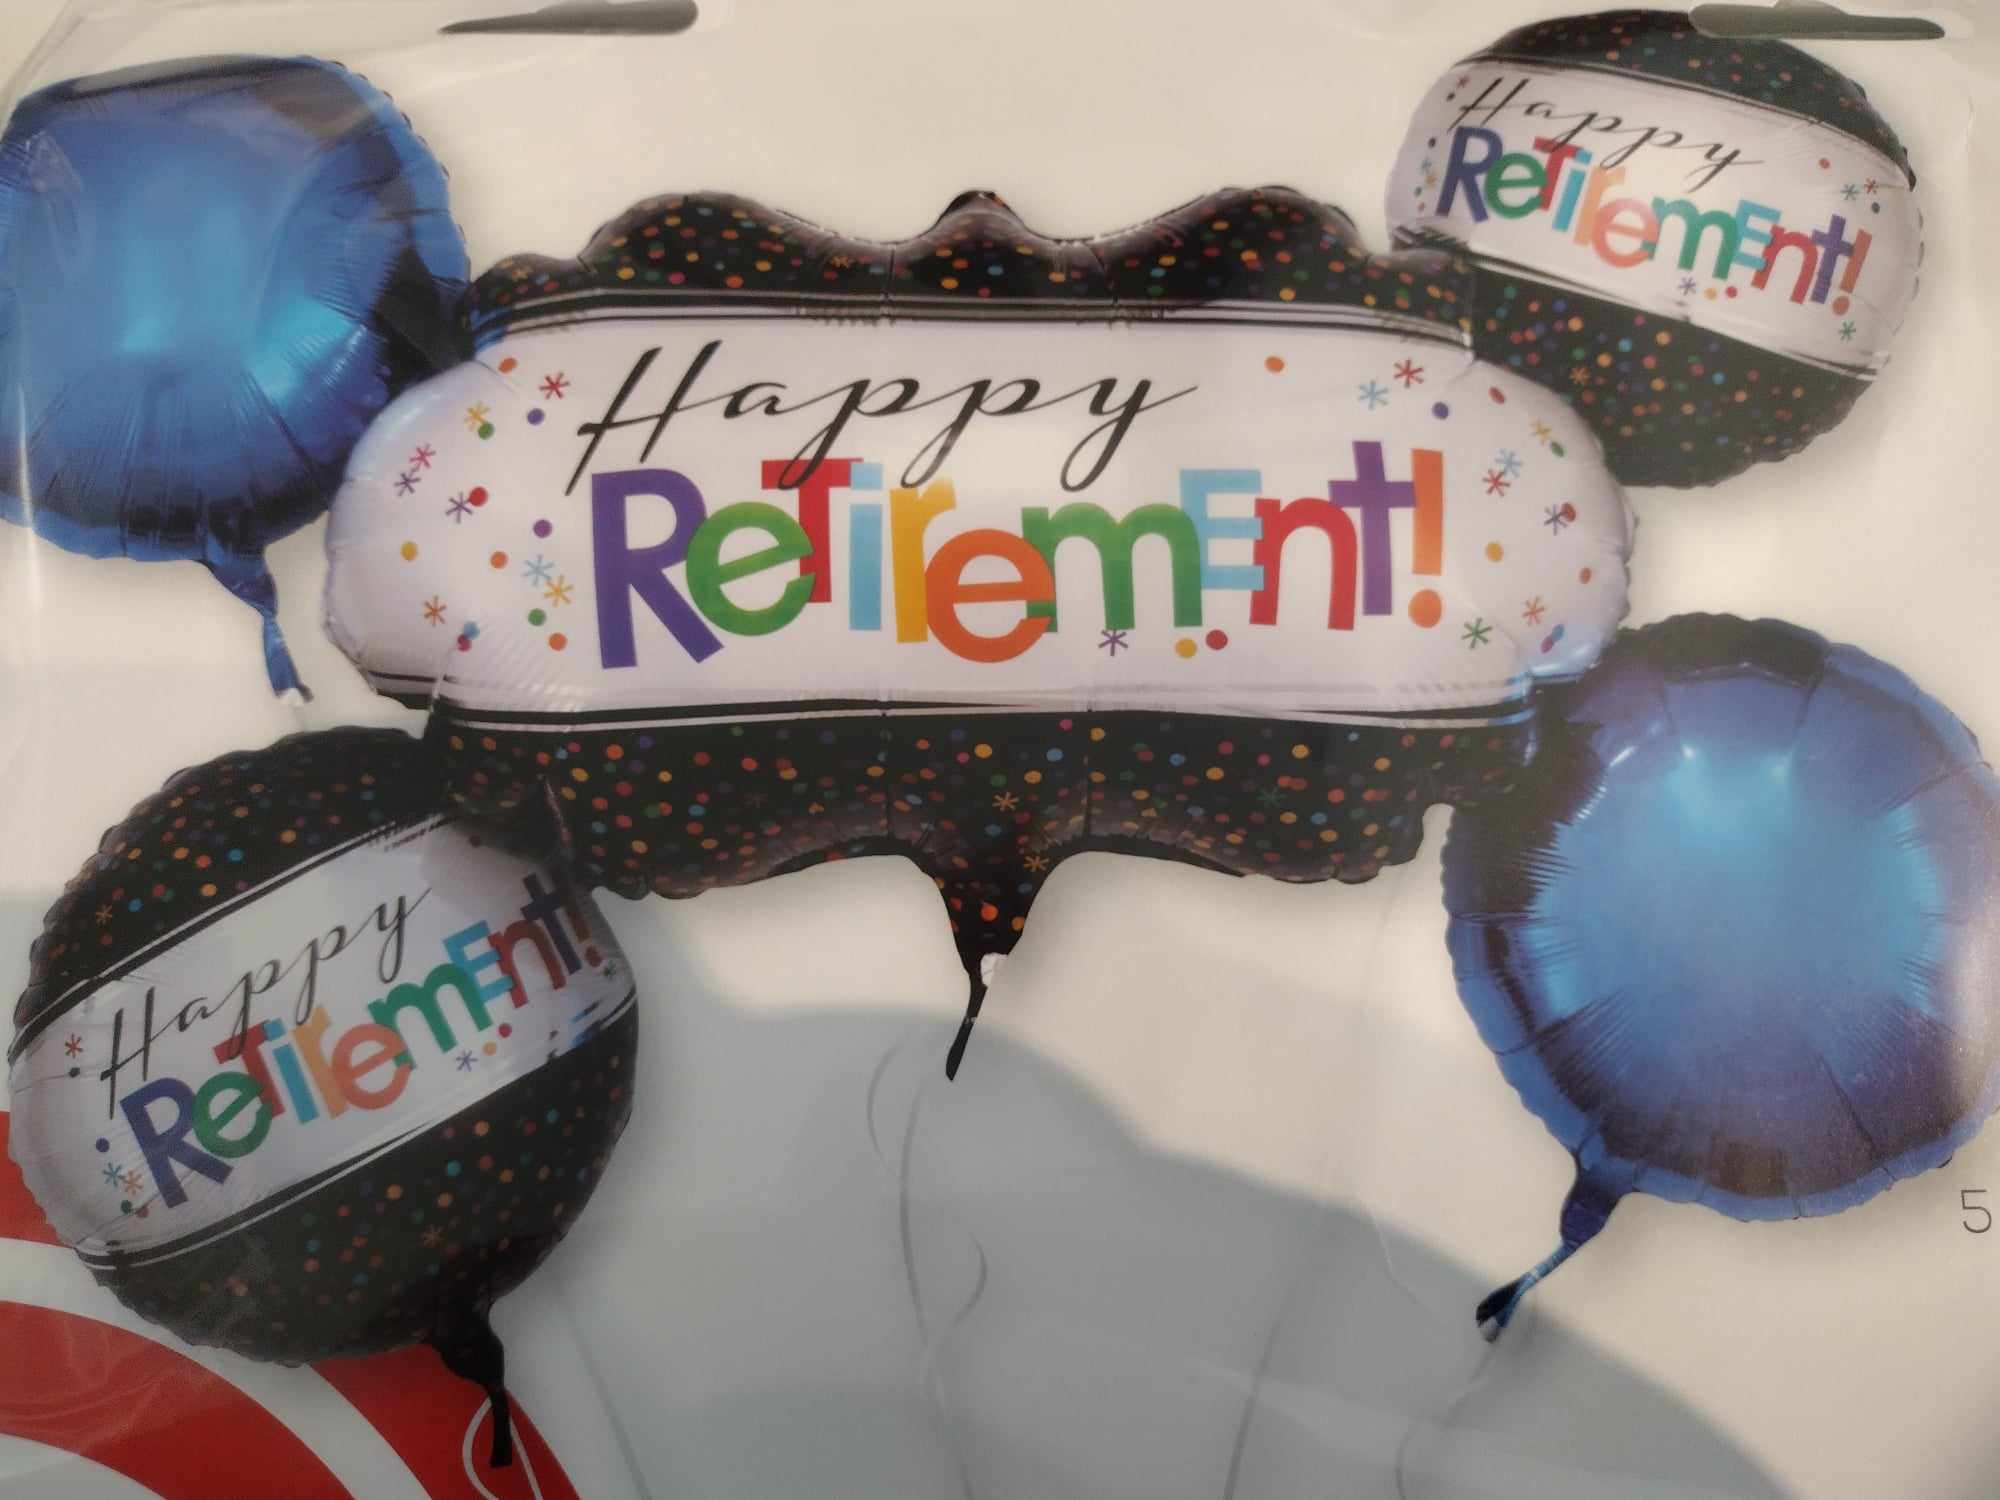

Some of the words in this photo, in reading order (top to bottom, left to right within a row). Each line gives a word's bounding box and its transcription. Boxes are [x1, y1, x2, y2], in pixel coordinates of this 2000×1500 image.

[1446, 76, 1764, 193] Happy
[564, 339, 1196, 495] Happy
[100, 886, 432, 1119] Happy
[1961, 1189, 1992, 1234] 5
